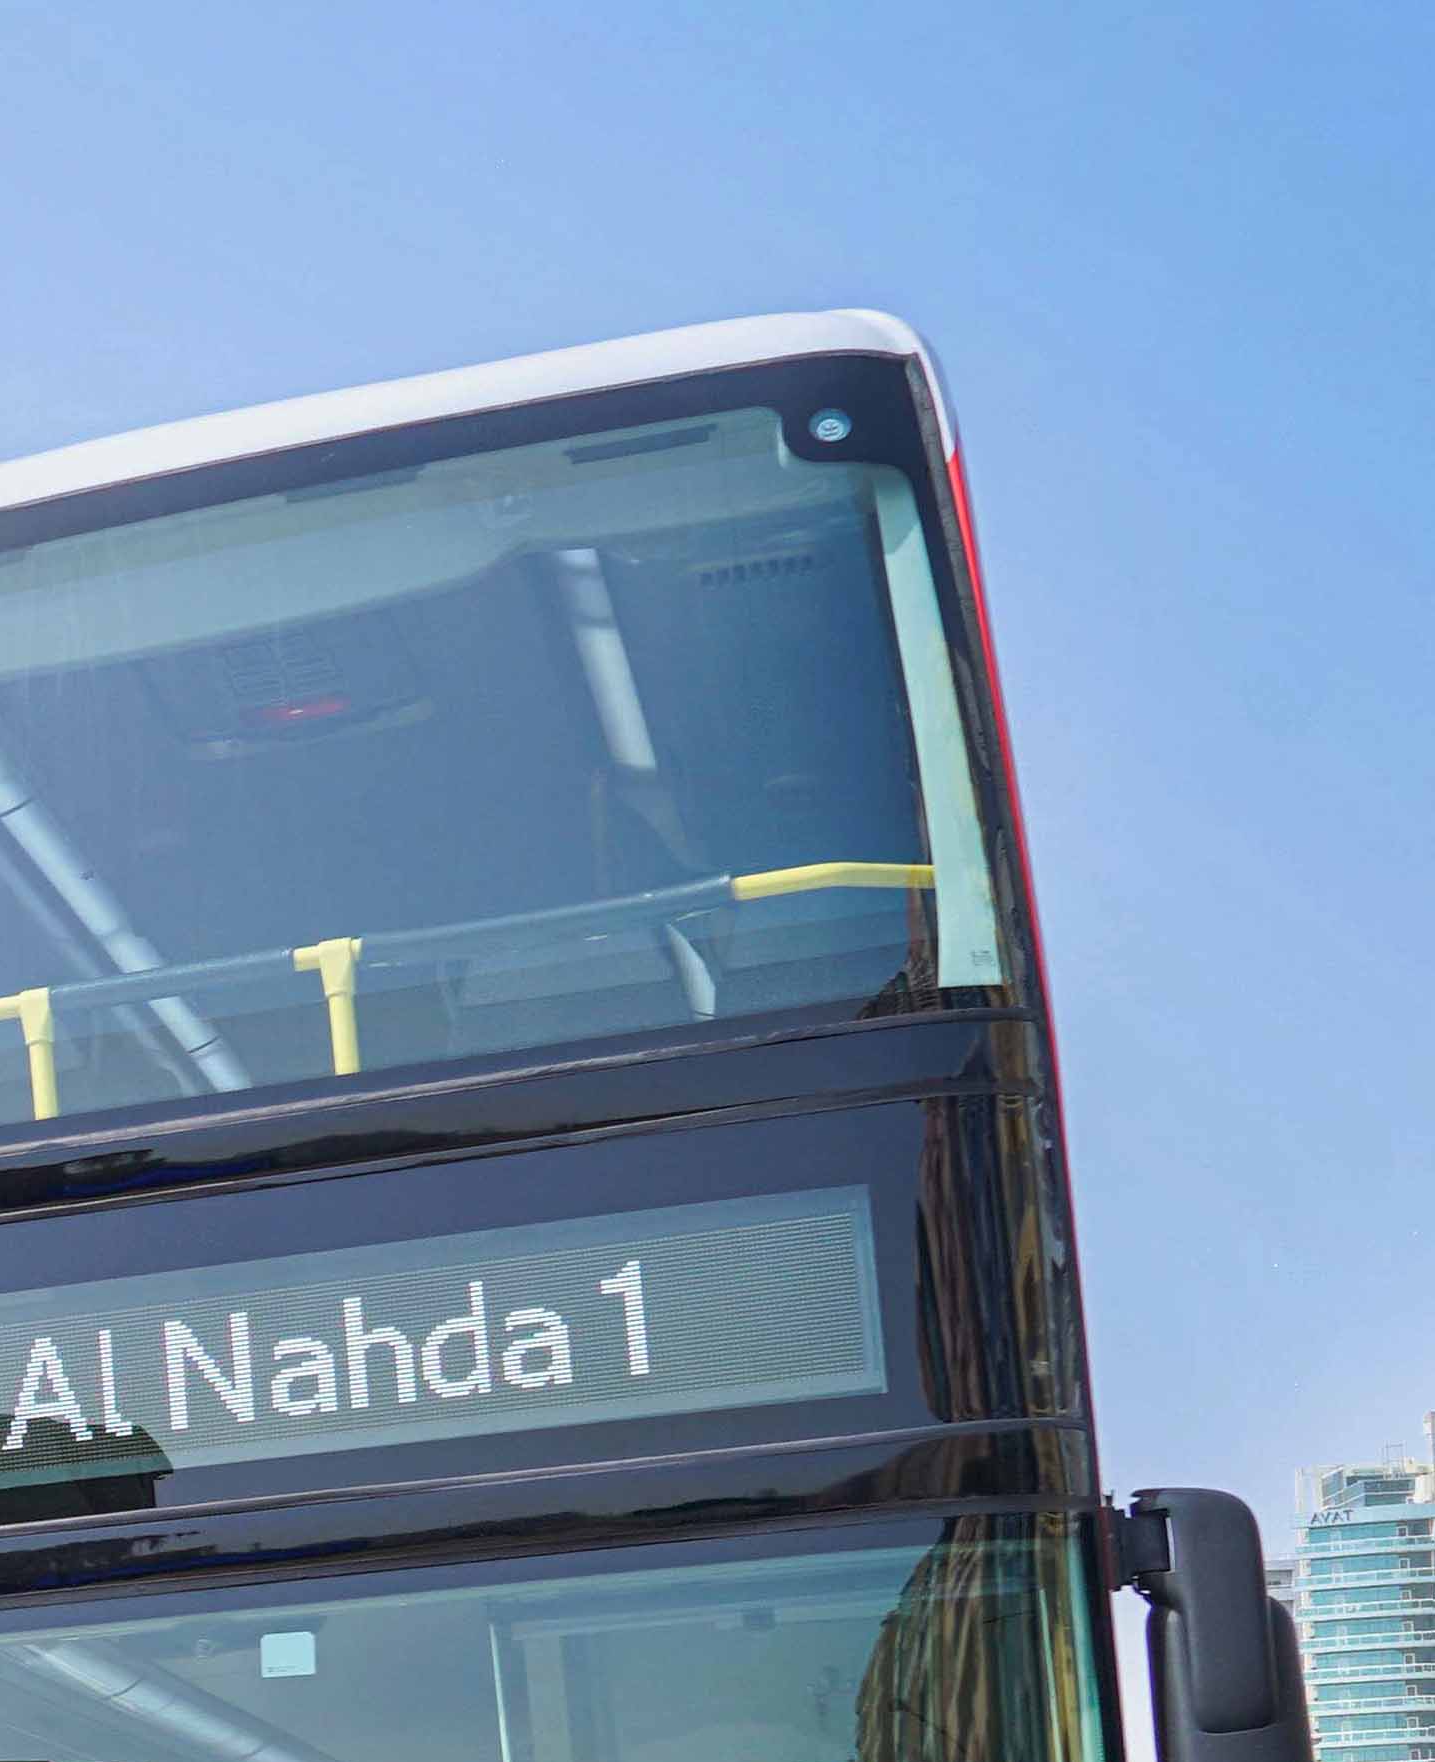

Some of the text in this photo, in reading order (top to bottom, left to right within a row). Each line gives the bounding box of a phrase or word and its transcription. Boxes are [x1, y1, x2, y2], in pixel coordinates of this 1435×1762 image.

[0, 1259, 651, 1451] Al Nahda 1
